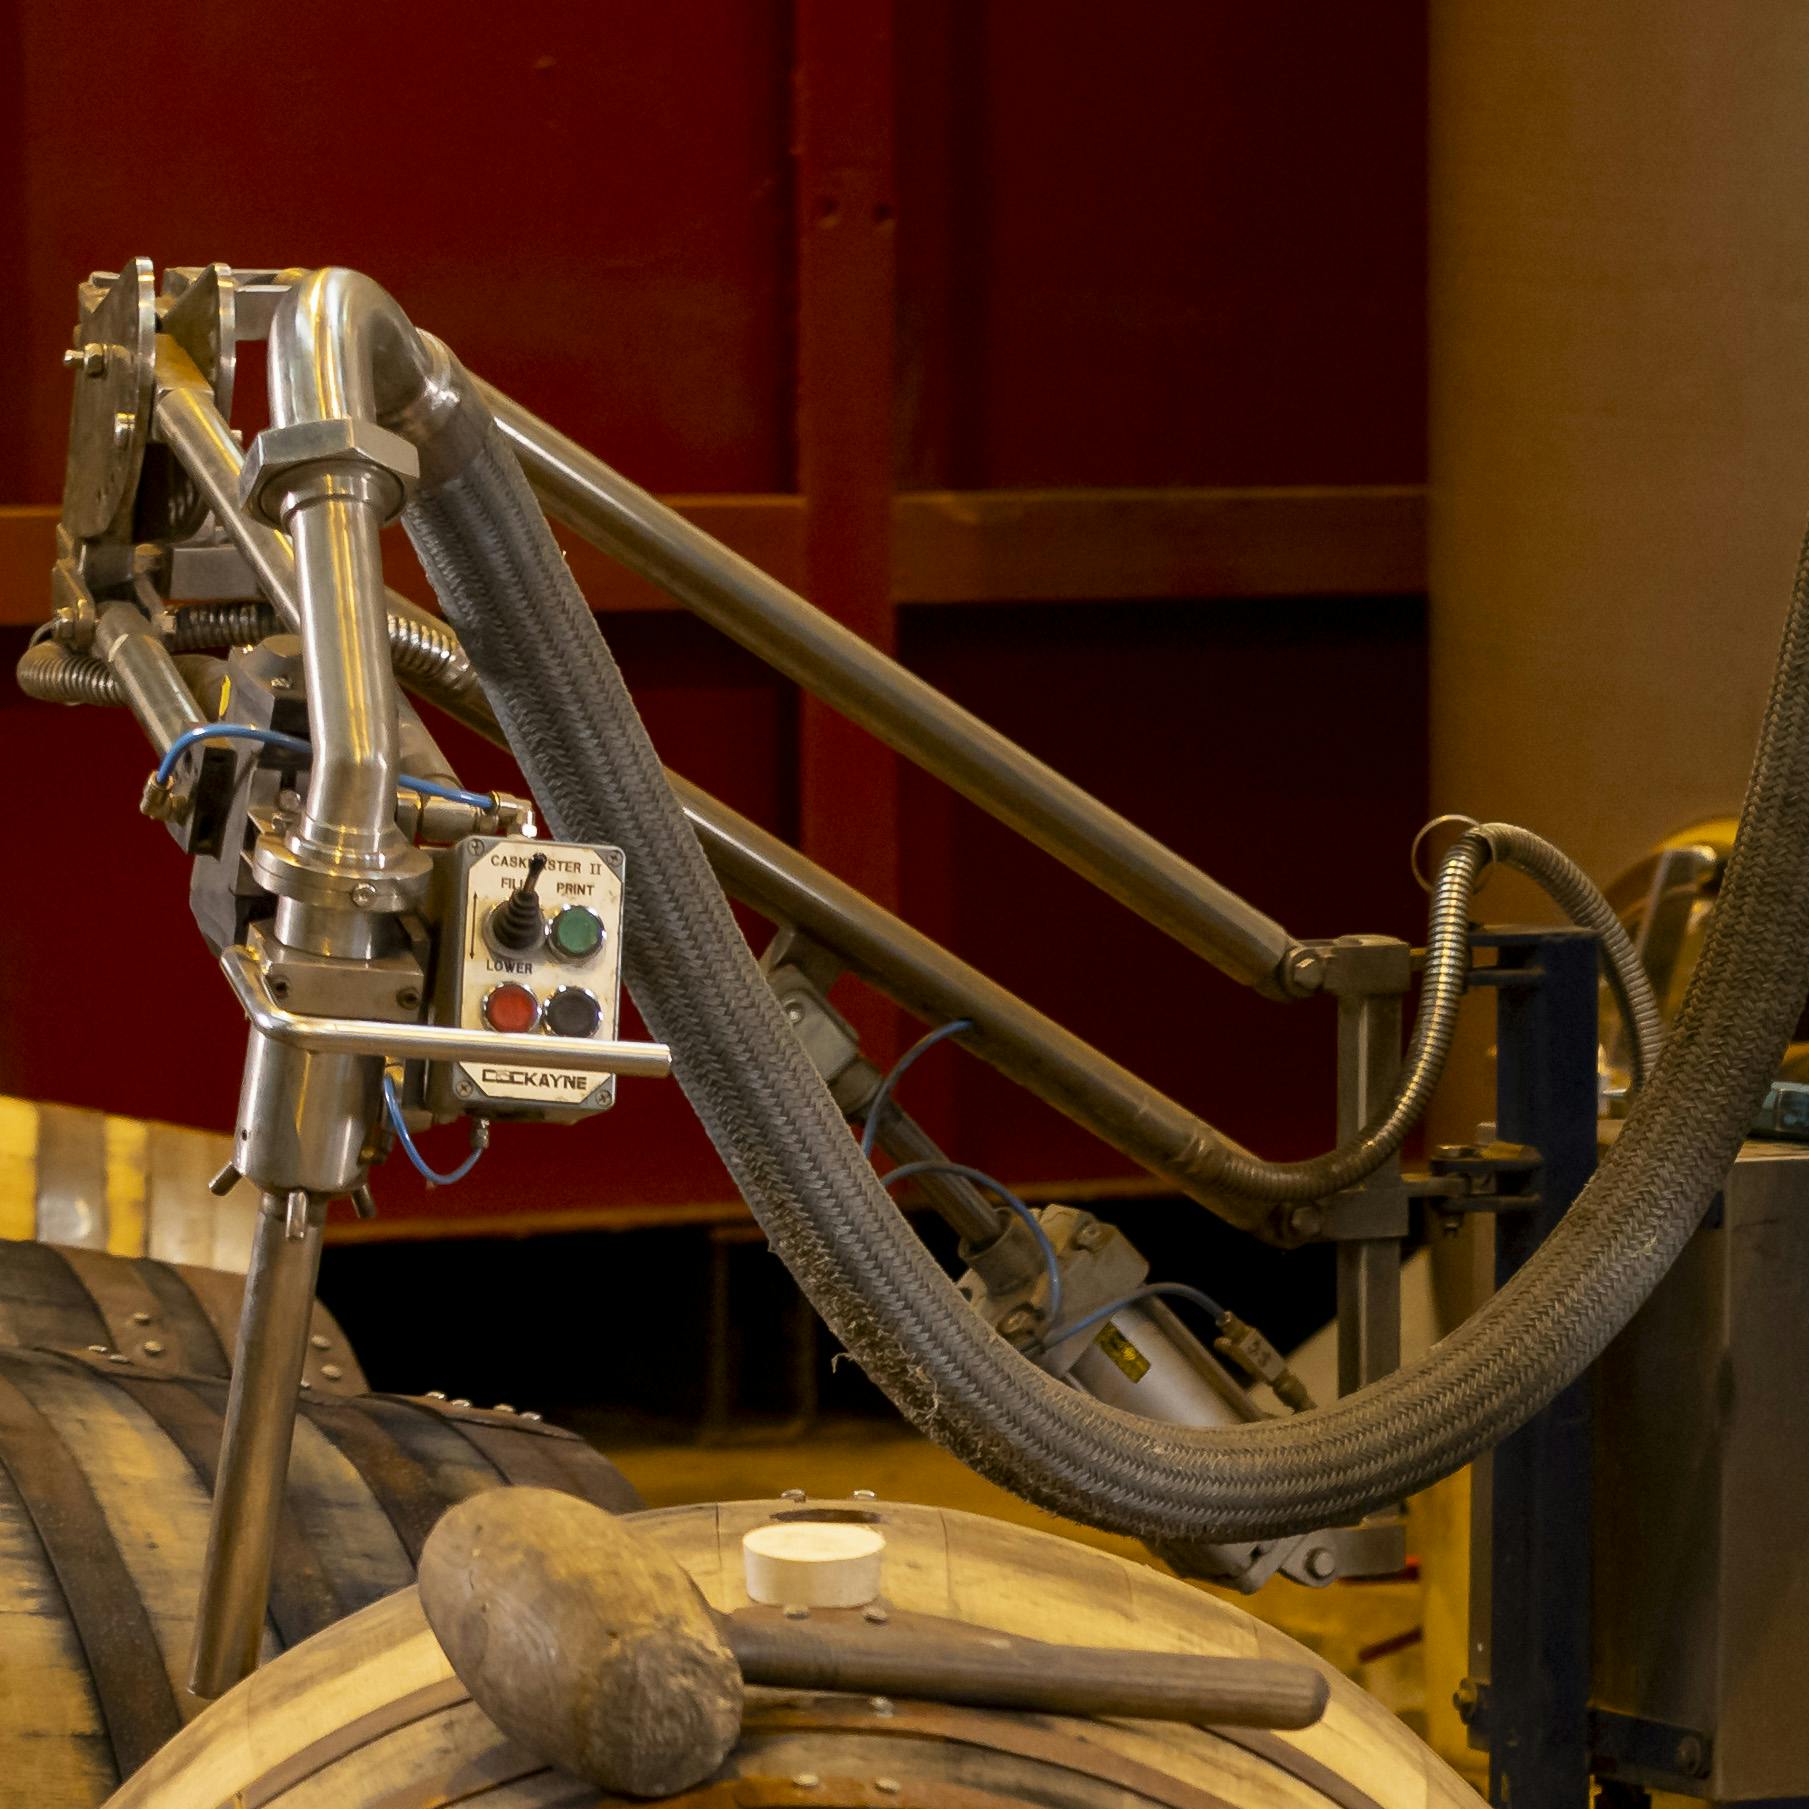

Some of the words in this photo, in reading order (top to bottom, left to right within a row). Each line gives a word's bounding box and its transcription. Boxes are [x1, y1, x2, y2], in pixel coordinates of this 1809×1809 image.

[490, 855, 581, 874] CASKSTER
[556, 882, 595, 897] PRINT
[486, 959, 533, 975] LOWER
